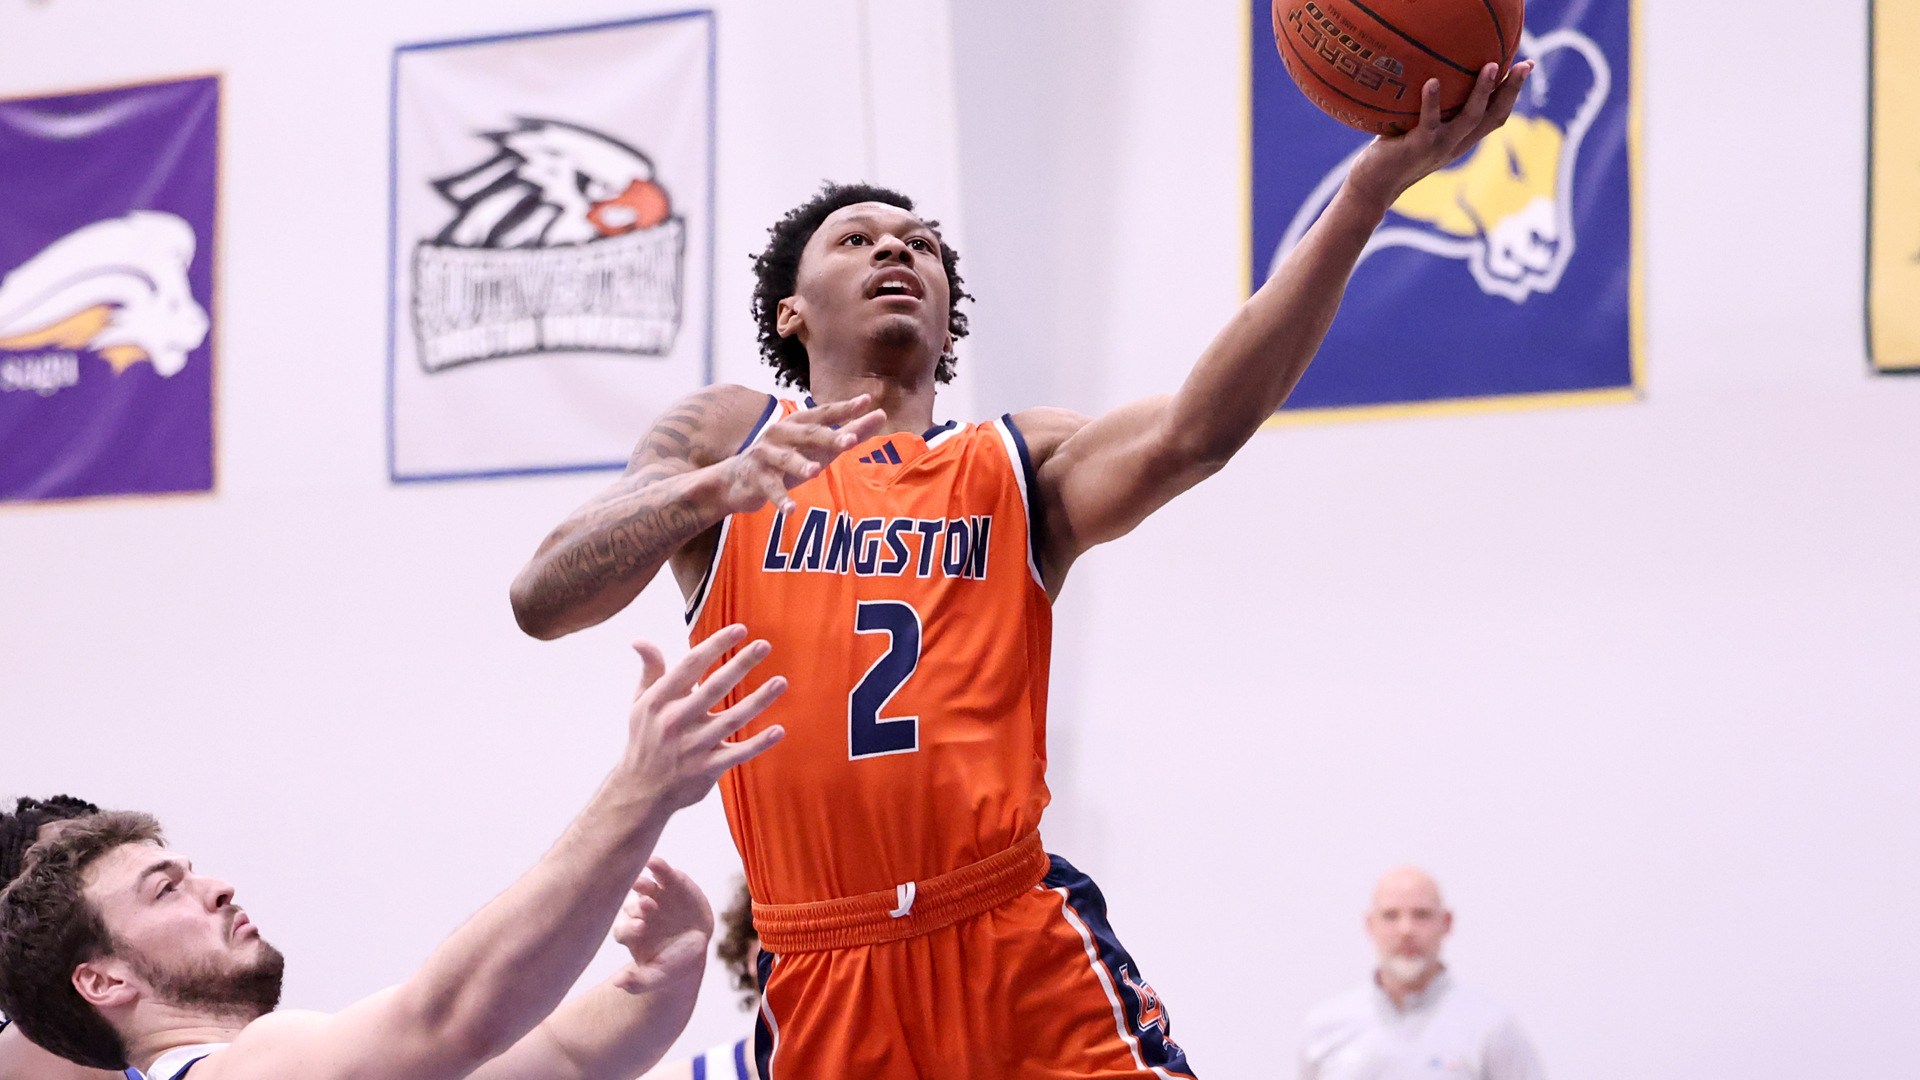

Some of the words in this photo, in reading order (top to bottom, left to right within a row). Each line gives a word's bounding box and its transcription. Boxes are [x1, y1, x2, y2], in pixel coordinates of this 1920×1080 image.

[1304, 1, 1375, 61] 1000
[1326, 4, 1342, 20] BALL
[1288, 8, 1408, 100] LEGACY
[762, 505, 993, 581] LANGSTON
[848, 599, 923, 761] 2
